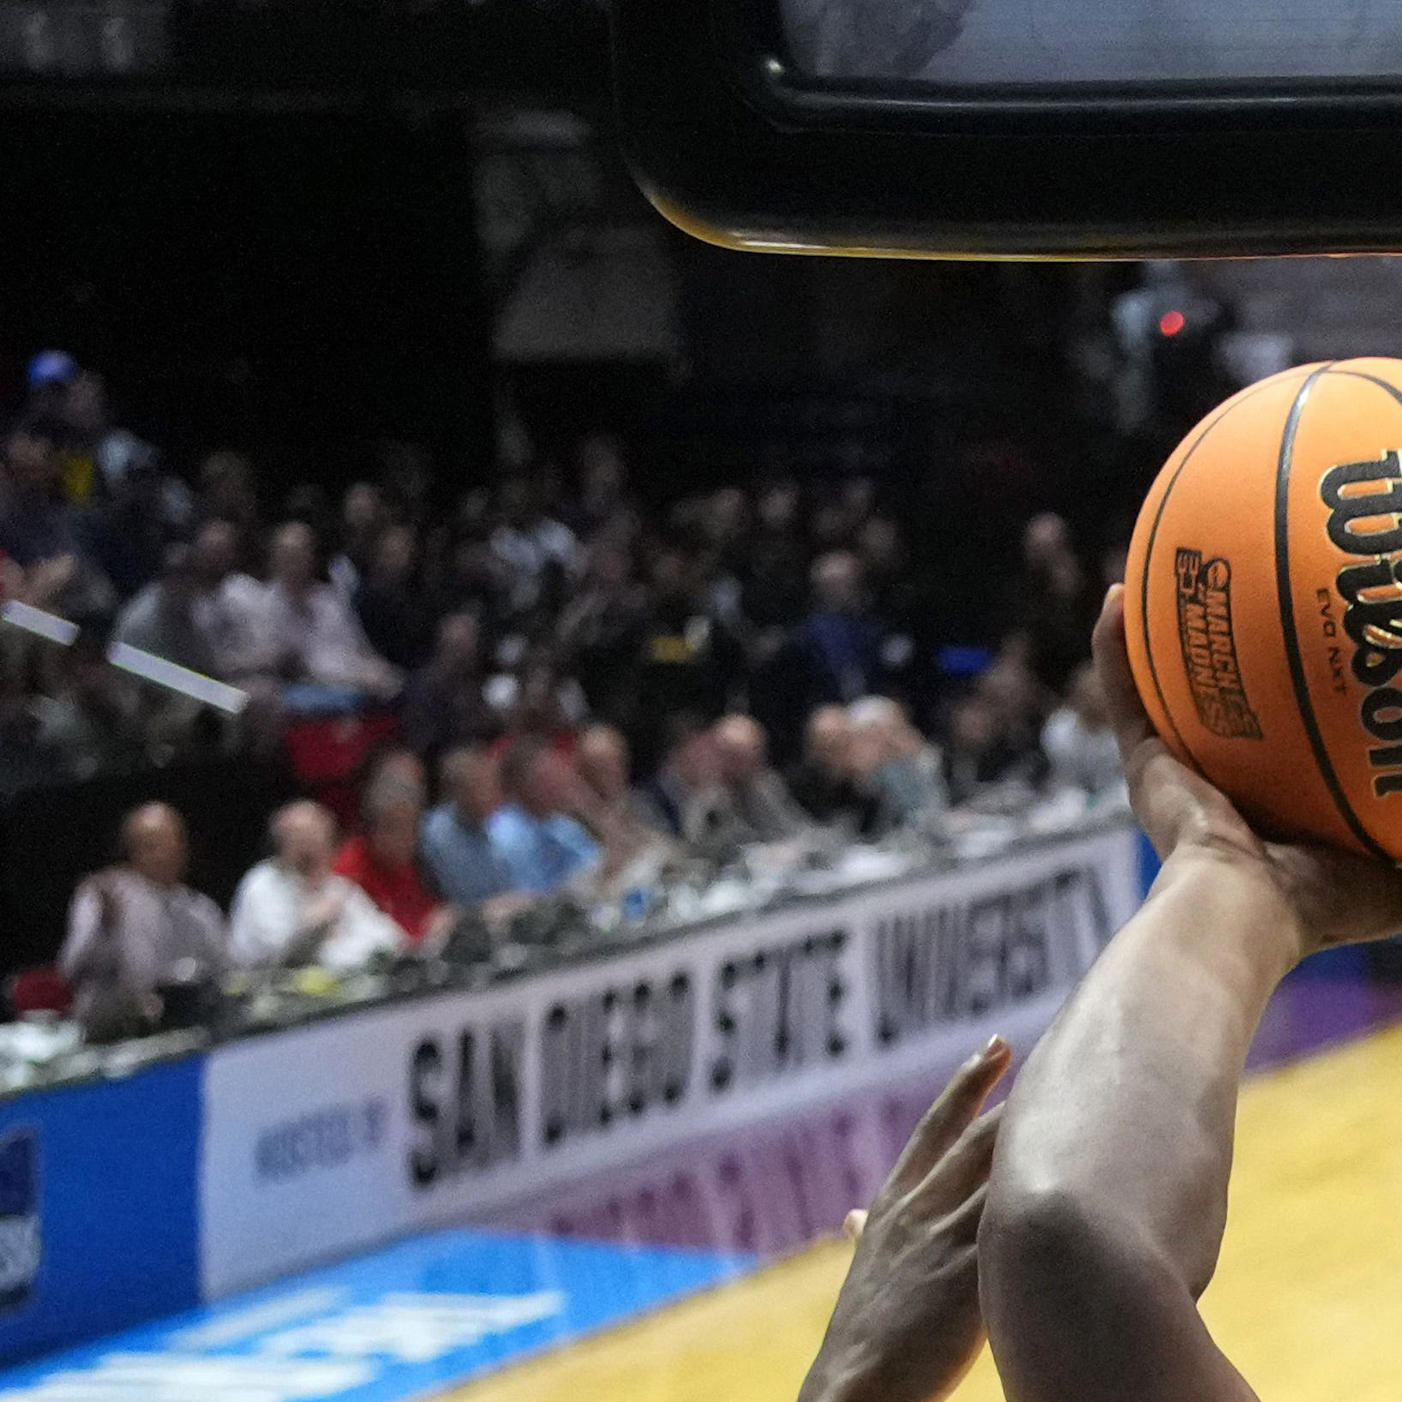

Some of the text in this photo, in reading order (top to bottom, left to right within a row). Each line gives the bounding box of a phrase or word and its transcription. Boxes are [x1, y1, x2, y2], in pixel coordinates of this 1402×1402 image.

[1205, 590, 1242, 690] MARCH
[1316, 588, 1336, 636] EVO
[410, 1028, 524, 1190] SAN
[538, 968, 694, 1150] DIEGO
[711, 923, 848, 1092] STATE
